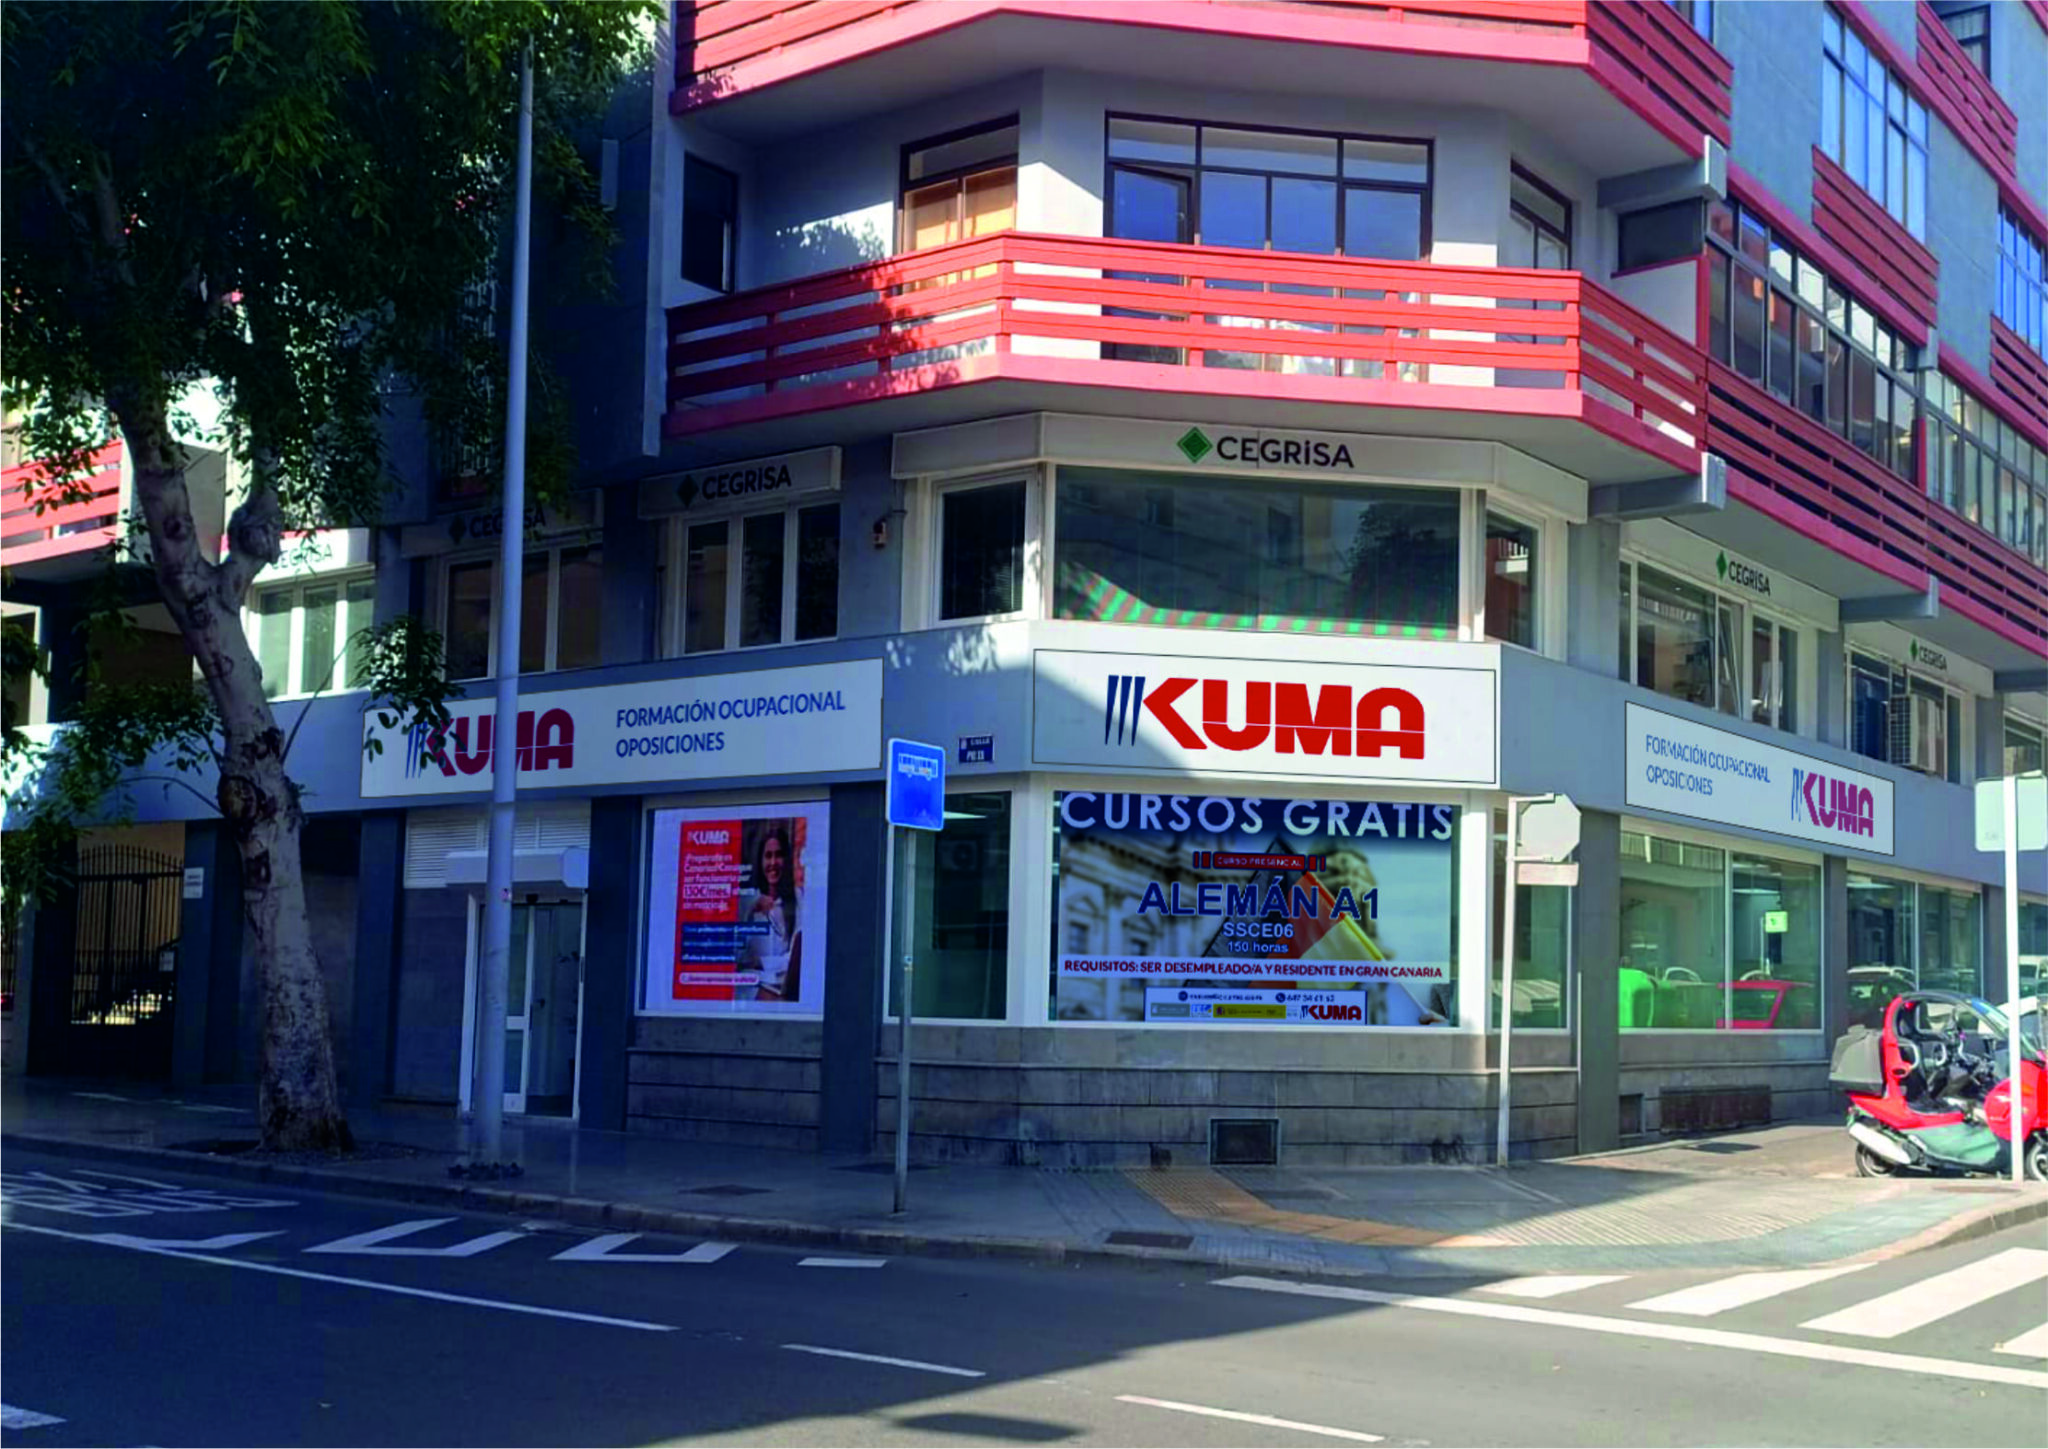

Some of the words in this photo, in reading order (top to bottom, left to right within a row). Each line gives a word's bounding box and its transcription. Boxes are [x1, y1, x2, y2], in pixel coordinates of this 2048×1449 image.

[616, 699, 716, 729] FORMACIÓN
[718, 690, 846, 721] OCUPACIONAL
[1105, 675, 1425, 760] KUMA
[615, 731, 725, 758] OPOSICIONES
[1646, 734, 1707, 767] FORMACIÓN
[1708, 753, 1771, 783] OCUPACIONAL
[1646, 765, 1713, 796] OPOSICIONES
[1061, 792, 1263, 834] CURSOS
[1283, 799, 1453, 840] GRATIS
[1791, 767, 1874, 838] KUMA
[687, 830, 730, 844] KUMA
[1249, 857, 1303, 867] PRESENCAL
[1137, 875, 1319, 918] ALEMÁN
[1330, 888, 1378, 919] A1
[1222, 922, 1294, 938] SSCE06
[1228, 940, 1249, 953] 150
[1252, 941, 1289, 953] horas
[1064, 960, 1139, 973] REQUISITOS:
[1140, 962, 1162, 973] SER
[1264, 965, 1274, 975] Y
[1274, 964, 1337, 976] RESIDENTE
[1338, 966, 1354, 976] EN
[1355, 965, 1389, 977] GRAN
[1390, 966, 1443, 978] CANARIA
[1301, 1005, 1362, 1020] KUMA
